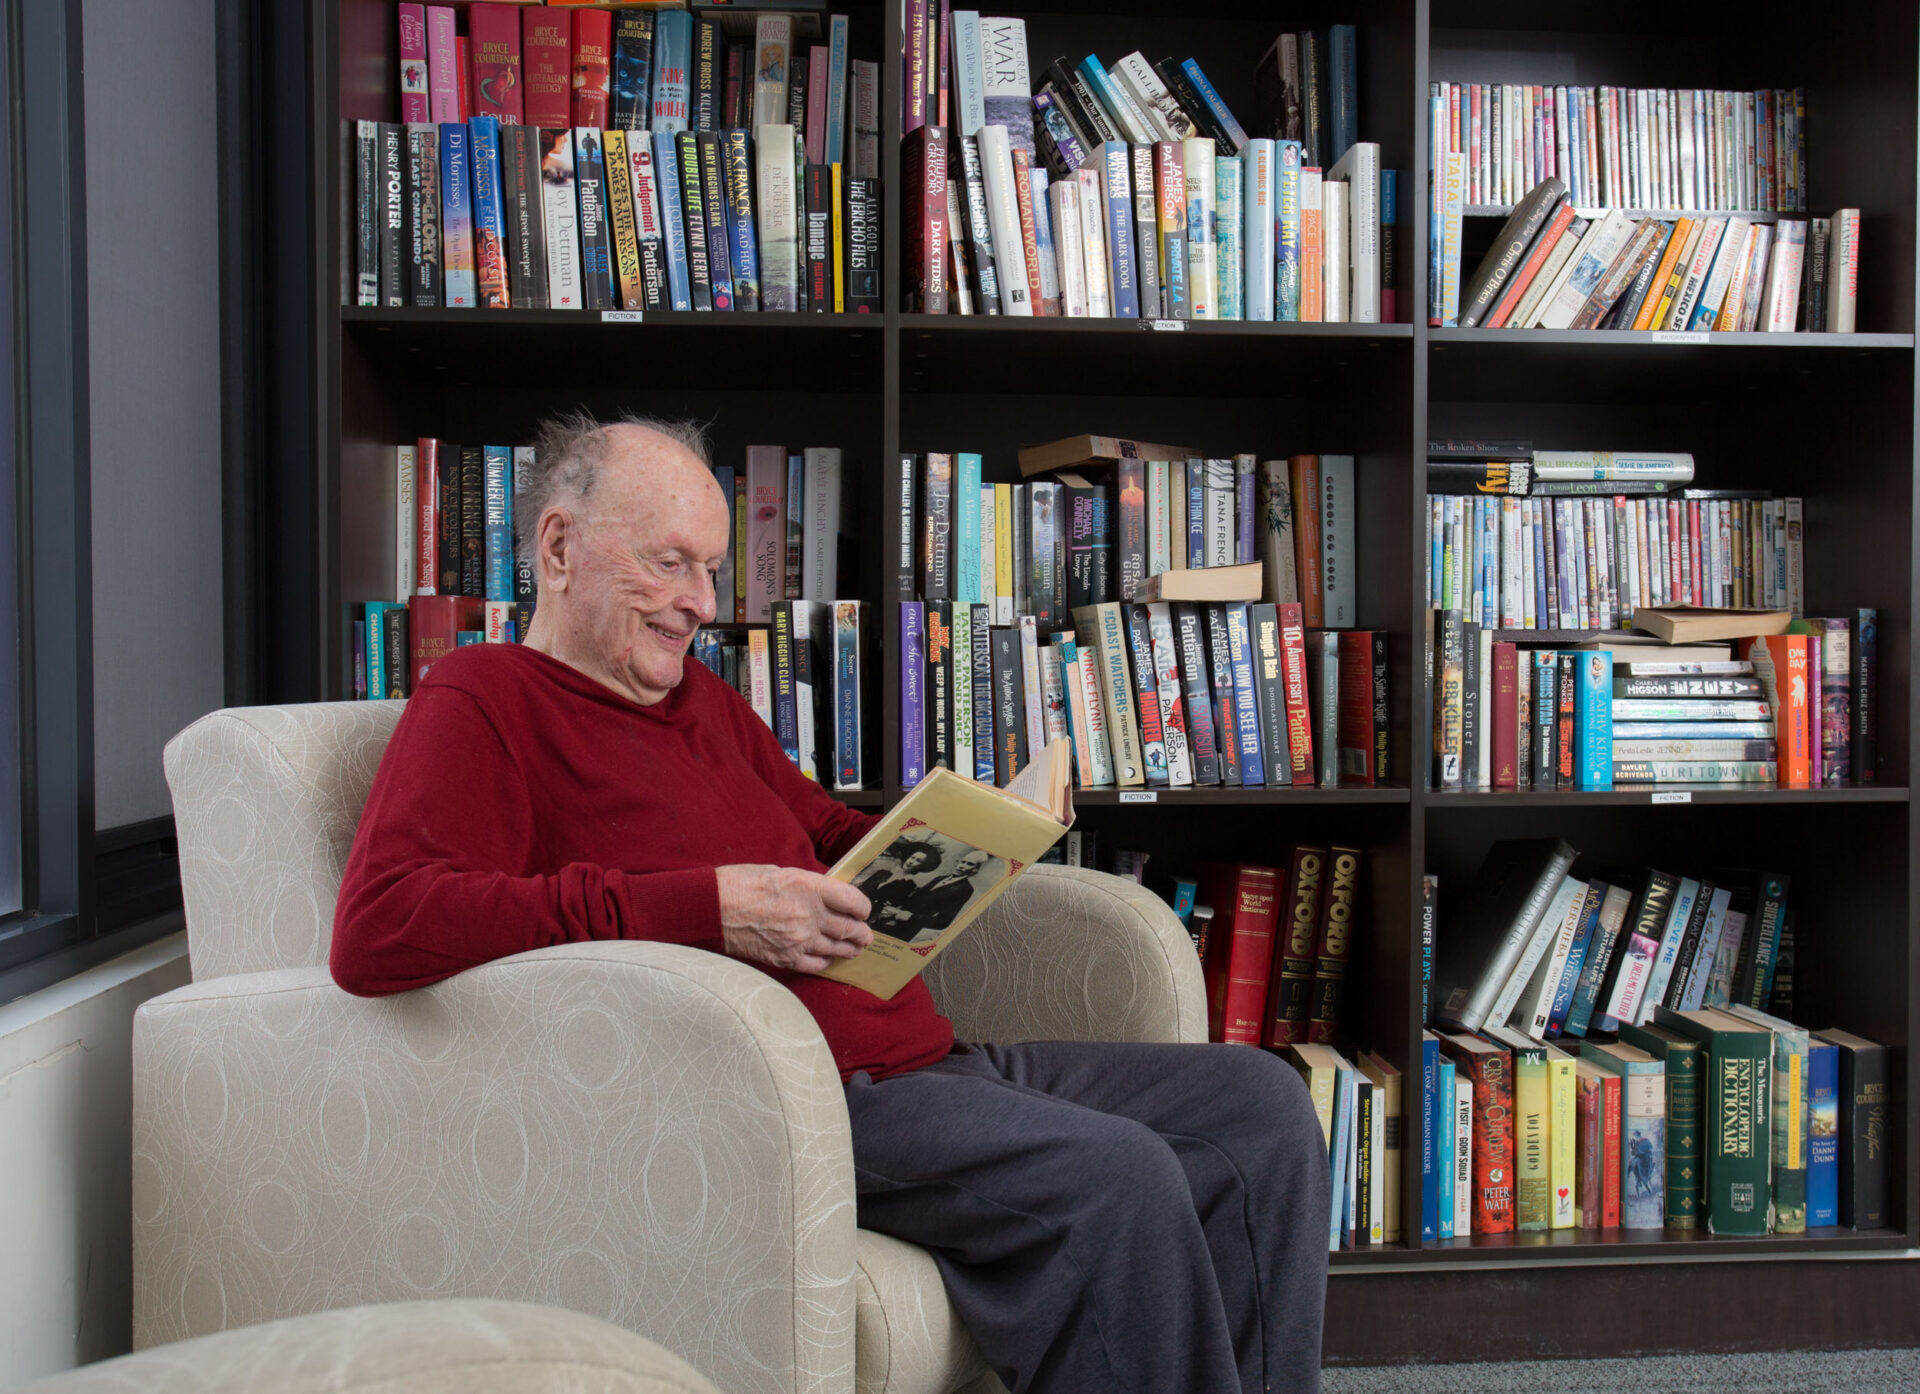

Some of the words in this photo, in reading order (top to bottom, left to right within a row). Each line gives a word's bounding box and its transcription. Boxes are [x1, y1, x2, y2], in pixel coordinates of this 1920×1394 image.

[483, 43, 509, 53] BRYCE
[527, 37, 568, 47] COURTENAY
[534, 27, 558, 38] BRYCE
[701, 23, 712, 60] ANDREW
[981, 23, 990, 39] LES
[474, 54, 520, 65] COURTENAY
[575, 55, 609, 65] COURTENAY
[581, 45, 602, 56] BRYCE
[983, 41, 994, 87] CARLYON
[992, 25, 1016, 85] WAR
[700, 61, 711, 90] GROSS
[700, 93, 711, 128] KILLING
[387, 132, 398, 170] HENRY
[410, 133, 419, 154] THE
[450, 133, 462, 149] Di
[705, 144, 715, 165] MARY
[730, 132, 746, 166] DICK
[962, 139, 981, 177] JACK
[411, 160, 420, 187] LAST
[449, 152, 463, 210] Morrissey
[683, 146, 698, 185] DOUBLE
[706, 167, 718, 199] HIGGINS
[927, 142, 937, 197] GREGORY
[935, 147, 945, 194] PHILIPPA
[1107, 151, 1120, 199] WALTERS
[1116, 151, 1130, 199] MINETTE
[1142, 149, 1154, 191] MINETTE
[1162, 145, 1176, 220] PATTERSON
[1172, 161, 1184, 203] JAMES
[1447, 155, 1461, 203] TARA
[387, 171, 402, 229] PORTER
[557, 185, 572, 208] Joy
[686, 189, 702, 212] LIFE
[734, 168, 751, 216] FRANCIS
[851, 181, 865, 197] THE
[1282, 170, 1298, 215] PETER
[581, 179, 598, 236] Patterson
[607, 151, 620, 193] JAMES
[615, 198, 630, 276] PATTERSON
[709, 201, 722, 228] CLARK
[848, 200, 866, 245] JERICHO
[969, 181, 990, 240] HIGGINS
[1115, 208, 1126, 227] THE
[412, 191, 421, 265] COMMANDO
[689, 214, 706, 248] FLYNN
[737, 219, 748, 247] DEAD
[809, 212, 828, 260] Damage
[930, 220, 942, 254] DARK
[1017, 171, 1032, 229] ROMAN
[1026, 231, 1041, 289] WORLD
[1117, 229, 1129, 258] DARK
[1143, 229, 1154, 257] ACID
[1281, 219, 1297, 249] KAY
[1444, 209, 1459, 257] JUNE
[557, 215, 573, 287] Dettman
[692, 250, 709, 286] BERRY
[740, 249, 751, 276] HEAT
[852, 247, 866, 268] FILES
[1504, 241, 1523, 267] Chris
[643, 241, 659, 304] Patterson
[931, 256, 943, 293] TIDES
[1120, 259, 1131, 289] ROOM
[1145, 260, 1156, 287] ROW
[1478, 267, 1507, 305] O'Brien
[1636, 262, 1655, 294] COBEN
[1443, 261, 1458, 320] WINCH
[608, 312, 637, 320] FICTION
[401, 453, 412, 504] RAMSES
[486, 455, 507, 526] SUMMERTIME
[1191, 488, 1203, 499] ON
[933, 491, 950, 516] Joy
[1073, 497, 1085, 539] CONNELLY
[1083, 498, 1093, 537] MICHAEL
[1191, 502, 1203, 520] THIN
[1191, 521, 1203, 534] ICE
[935, 522, 950, 588] Dettman
[1123, 561, 1133, 600] GIRLS
[371, 613, 379, 666] CHARLOTTE
[776, 611, 787, 633] MARY
[955, 615, 963, 655] FOUR
[961, 612, 970, 662] JAMES
[1228, 610, 1243, 661] Patterson
[1260, 621, 1276, 658] Shuggie
[777, 635, 789, 668] HIGGINS
[973, 620, 990, 679] PATTERSON
[1132, 629, 1148, 689] PATTERSON
[1141, 641, 1153, 675] JAMES
[1180, 615, 1199, 681] Patterson
[1219, 625, 1231, 664] JAMES
[1788, 648, 1806, 659] ONE
[779, 669, 791, 695] CLARK
[936, 666, 944, 686] WEEP
[956, 659, 964, 702] BLIND
[1083, 649, 1097, 689] VINCE
[1234, 664, 1250, 688] NOW
[1264, 659, 1278, 680] Bain
[1539, 668, 1554, 697] CHRIS
[1789, 659, 1806, 671] DAY
[937, 687, 944, 698] NO
[963, 666, 972, 748] PATTERSON
[1237, 689, 1252, 710] YOU
[1268, 688, 1276, 723] DOUGLAS
[1627, 684, 1667, 695] HIGSON
[936, 699, 945, 721] MORE,
[937, 722, 944, 733] MY
[1089, 692, 1103, 732] FLYNN
[1139, 691, 1163, 743] HAUNTED
[1222, 699, 1232, 729] PRIVATE
[1240, 711, 1254, 731] SEE
[1465, 692, 1477, 746] Stoner
[1540, 699, 1553, 725] RYAN
[937, 734, 945, 753] LADY
[1161, 699, 1178, 764] PATTERSON
[1191, 703, 1214, 759] SWIMSUIT
[1224, 731, 1236, 766] SYDNEY
[1242, 733, 1258, 754] HER
[1271, 724, 1280, 755] STUART
[1290, 709, 1306, 771] Patterson
[1660, 766, 1693, 778] DIRT
[1699, 766, 1740, 778] TOWN
[1291, 854, 1321, 955] OXFORD
[1326, 854, 1357, 955] OXFORD
[1638, 883, 1670, 933] KING
[1670, 896, 1692, 944] BELIEVE
[1561, 947, 1583, 984] Winter
[1662, 947, 1676, 963] ME
[1553, 991, 1570, 1012] Sea
[1618, 961, 1645, 1018] DREAMCATCHER
[1757, 1058, 1766, 1076] The
[1459, 1107, 1469, 1126] VISIT
[1724, 1057, 1739, 1158] DICTIONARY
[1739, 1058, 1751, 1159] ENCYCLOPEDIC
[1756, 1078, 1767, 1124] Macquarie
[1423, 1139, 1431, 1174] FOLKLORE
[1459, 1136, 1469, 1157] GOON
[1812, 1146, 1836, 1154] DANNY
[1814, 1155, 1835, 1163] DUNN
[1458, 1157, 1468, 1182] SQUAD
[1484, 1187, 1510, 1199] PETER
[1484, 1199, 1509, 1211] WATT
